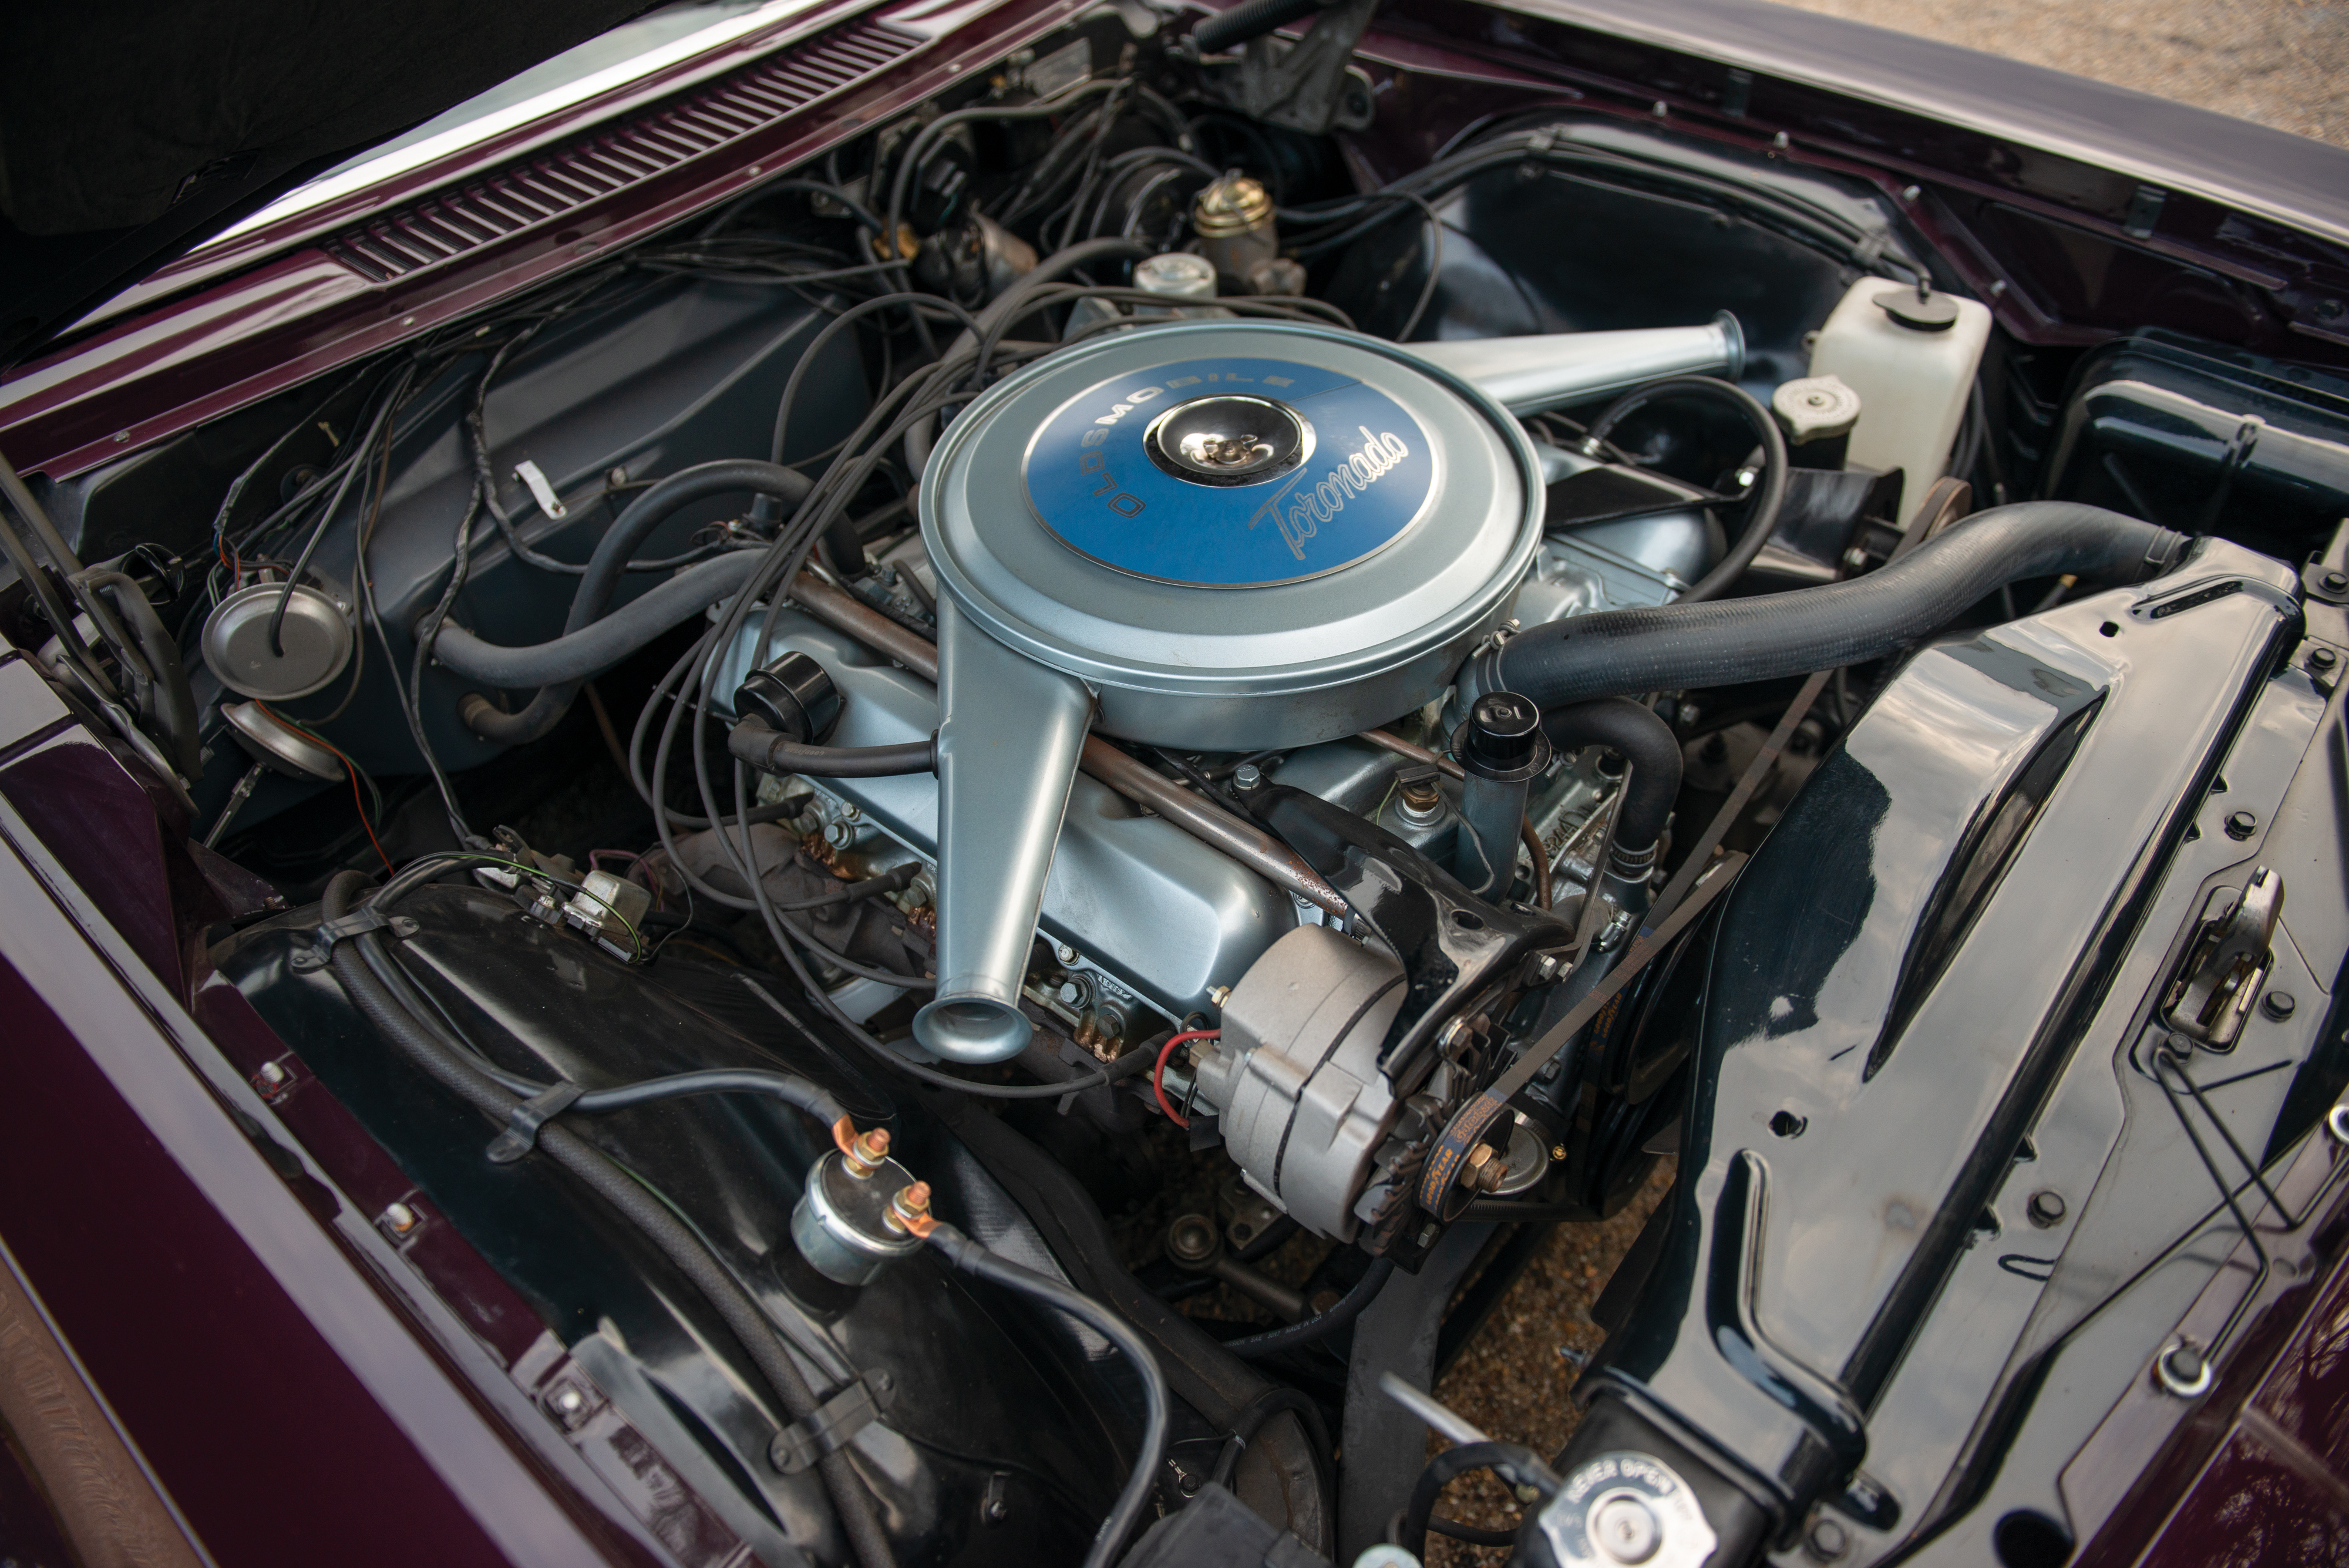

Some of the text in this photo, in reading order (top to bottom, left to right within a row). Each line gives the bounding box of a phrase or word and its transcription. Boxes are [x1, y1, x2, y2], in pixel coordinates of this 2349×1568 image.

[1079, 372, 1295, 519] OLDSMOBILE
[1248, 425, 1409, 560] Toronado
[1425, 1148, 1453, 1205] GOODYEAR
[1285, 1323, 1302, 1334] MADE
[1311, 1314, 1322, 1324] USA
[1620, 1458, 1674, 1495] OPEN
